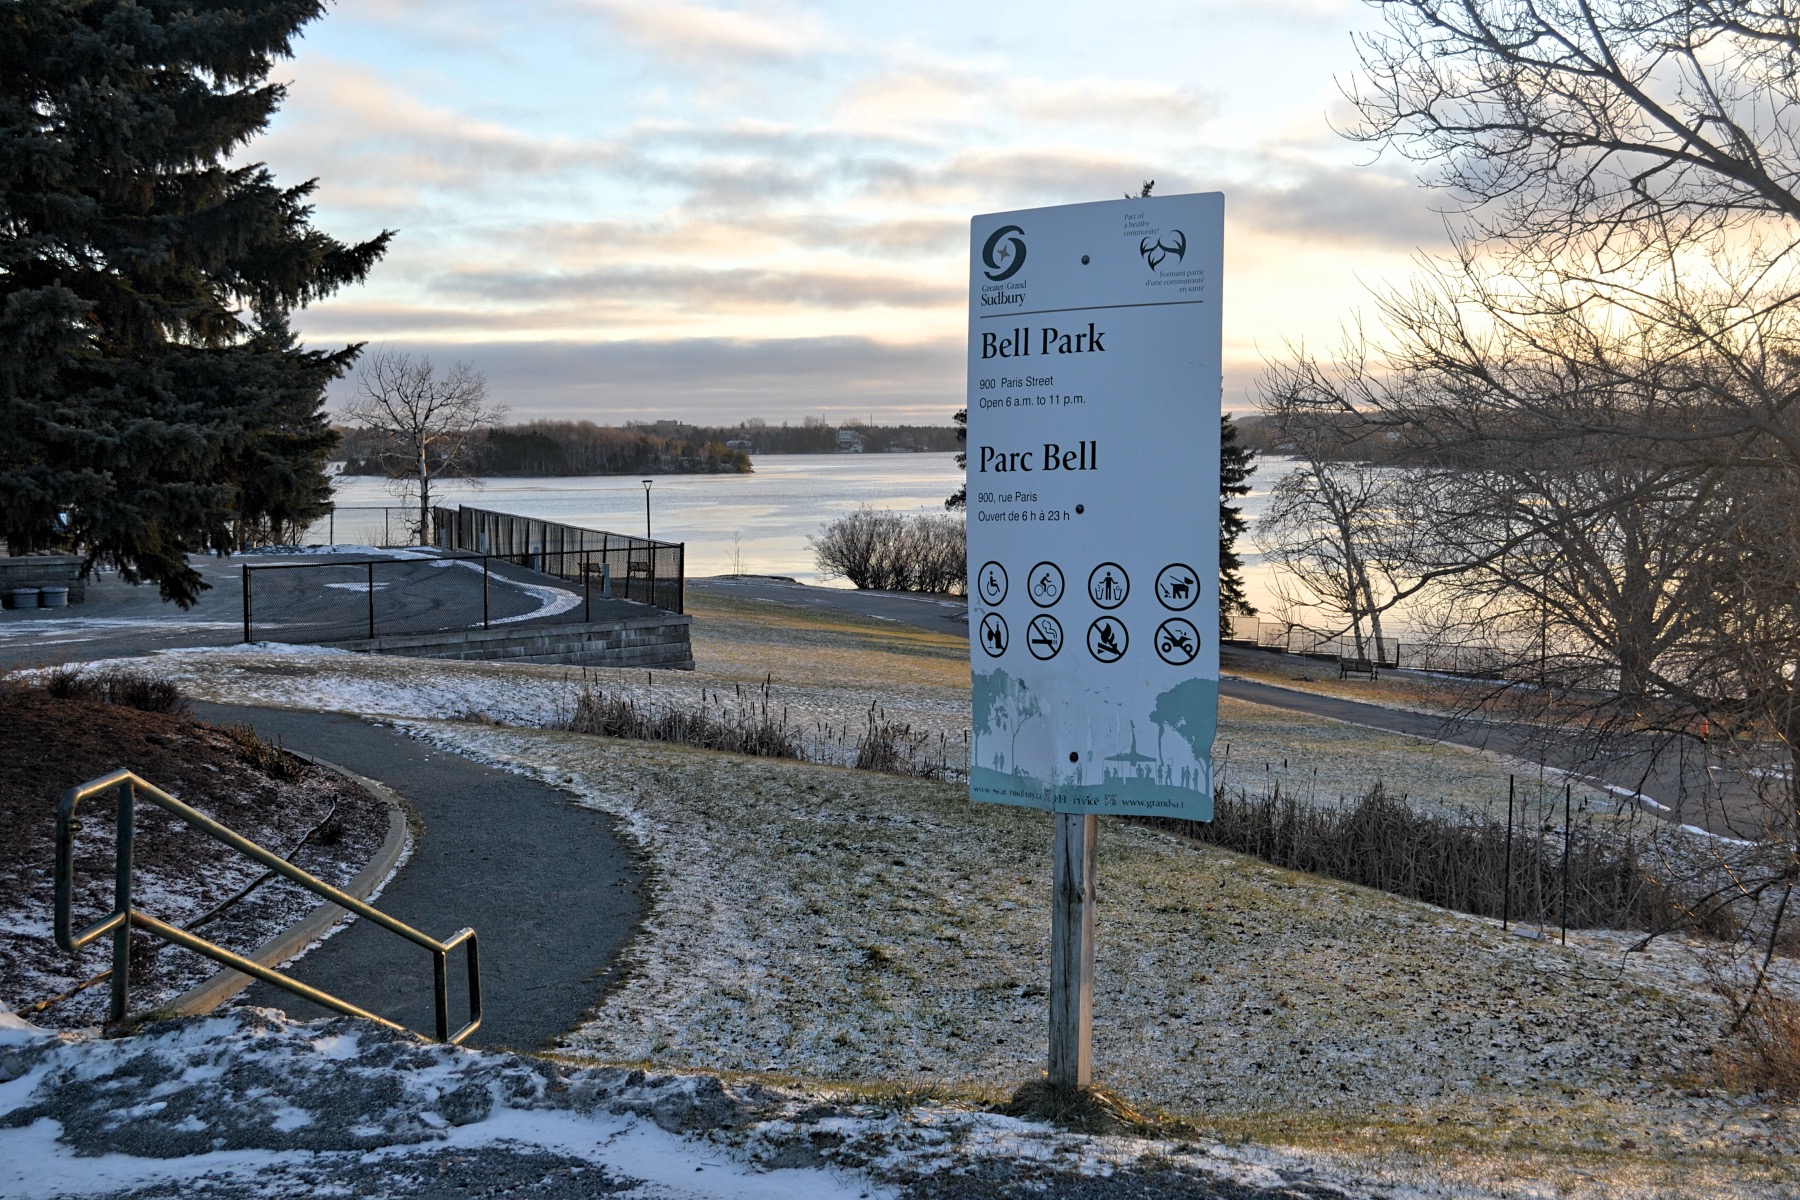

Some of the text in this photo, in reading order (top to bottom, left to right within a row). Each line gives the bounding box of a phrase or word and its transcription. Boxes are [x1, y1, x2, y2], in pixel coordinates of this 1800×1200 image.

[1129, 220, 1150, 229] healthy
[1123, 228, 1159, 237] community
[1186, 269, 1205, 278] partie
[982, 280, 1027, 292] Greater Grand
[981, 291, 1026, 307] Sudbury
[981, 322, 1106, 359] Bell Park
[979, 375, 1054, 390] 900 Paris Street
[979, 394, 1086, 410] Open 6 a.m. to 11 p.m.
[979, 440, 1098, 473] Parc Bell
[978, 491, 1038, 504] 900, rue Paris
[978, 509, 1070, 521] Ouvert de 6 h à 23 h
